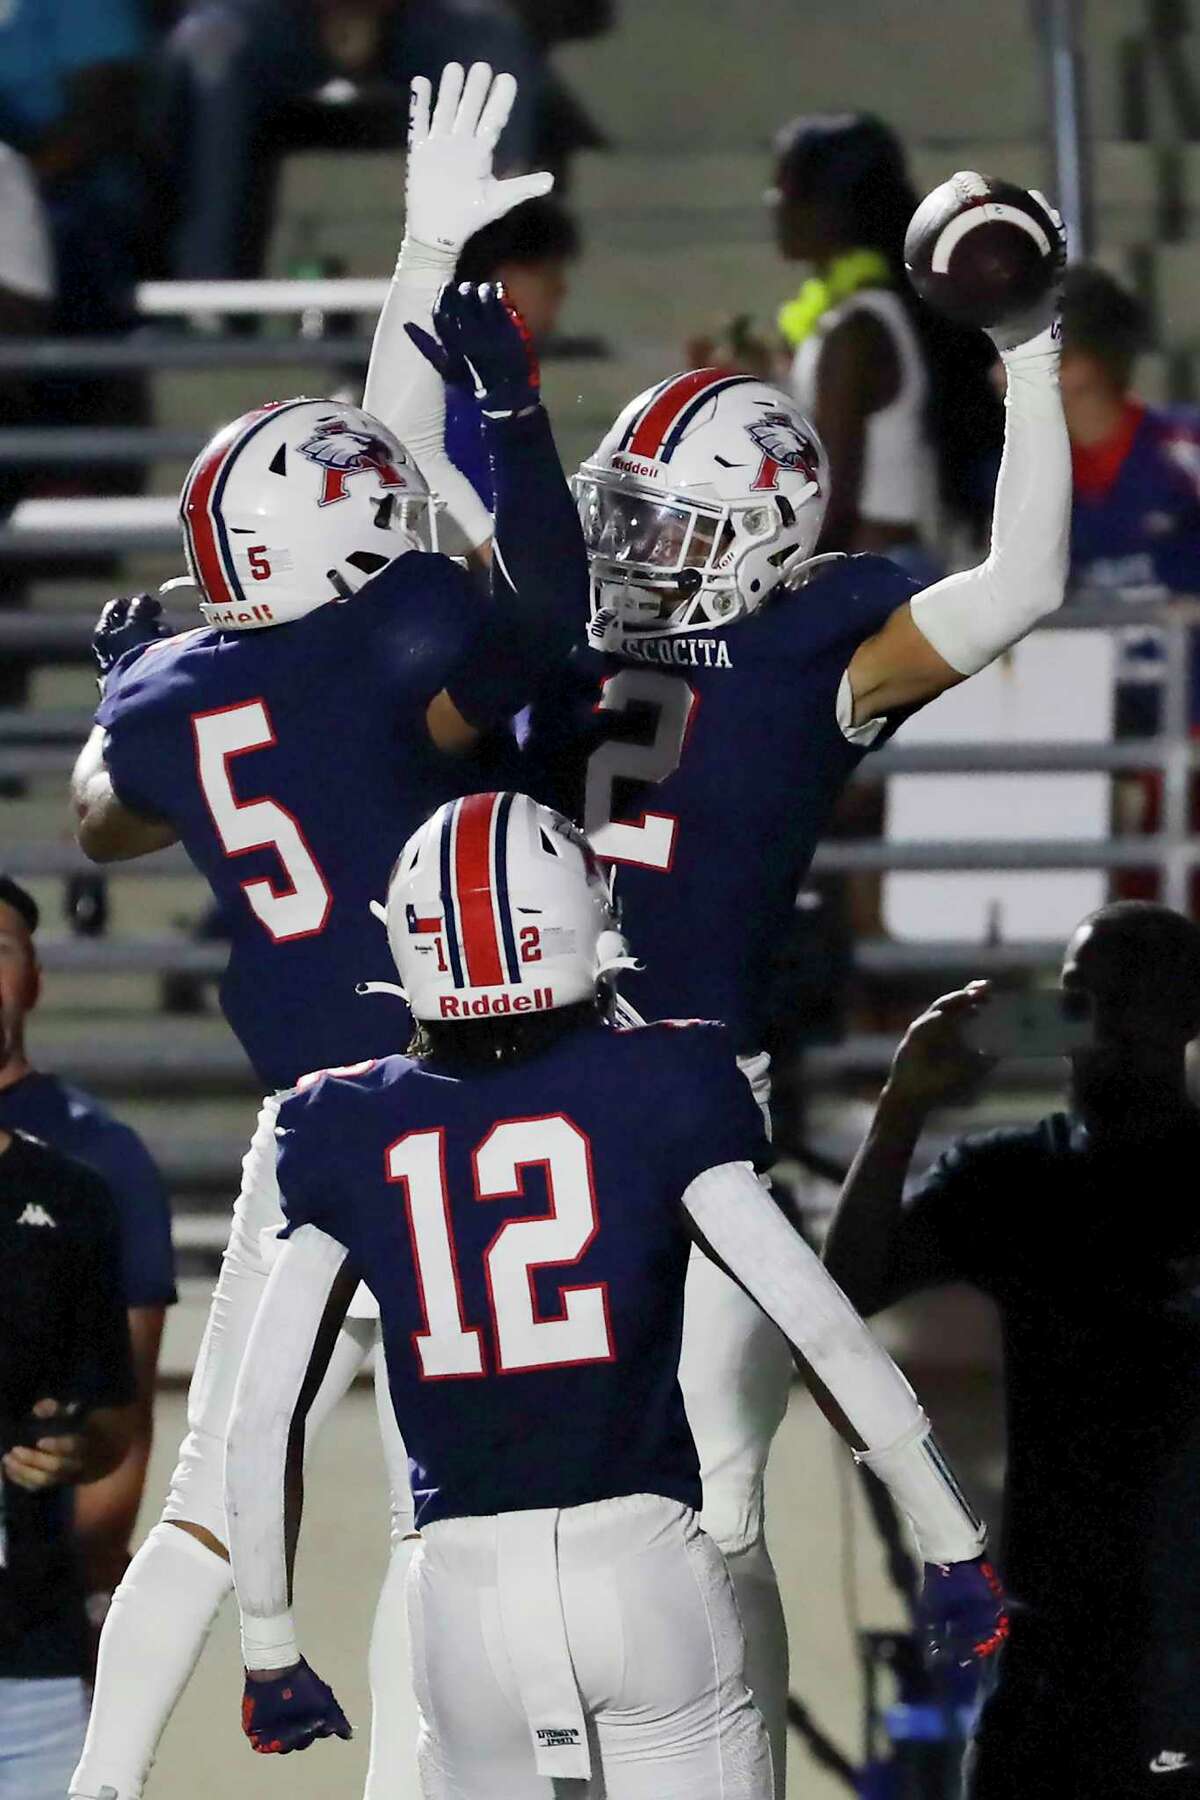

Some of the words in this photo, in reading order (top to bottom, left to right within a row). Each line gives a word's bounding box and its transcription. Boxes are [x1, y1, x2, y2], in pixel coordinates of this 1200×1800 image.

[247, 545, 271, 581] 5
[625, 638, 734, 669] SCOCITA
[190, 697, 333, 944] 5
[583, 668, 700, 874] 2
[439, 987, 554, 1018] Riddell
[384, 1111, 616, 1382] 12
